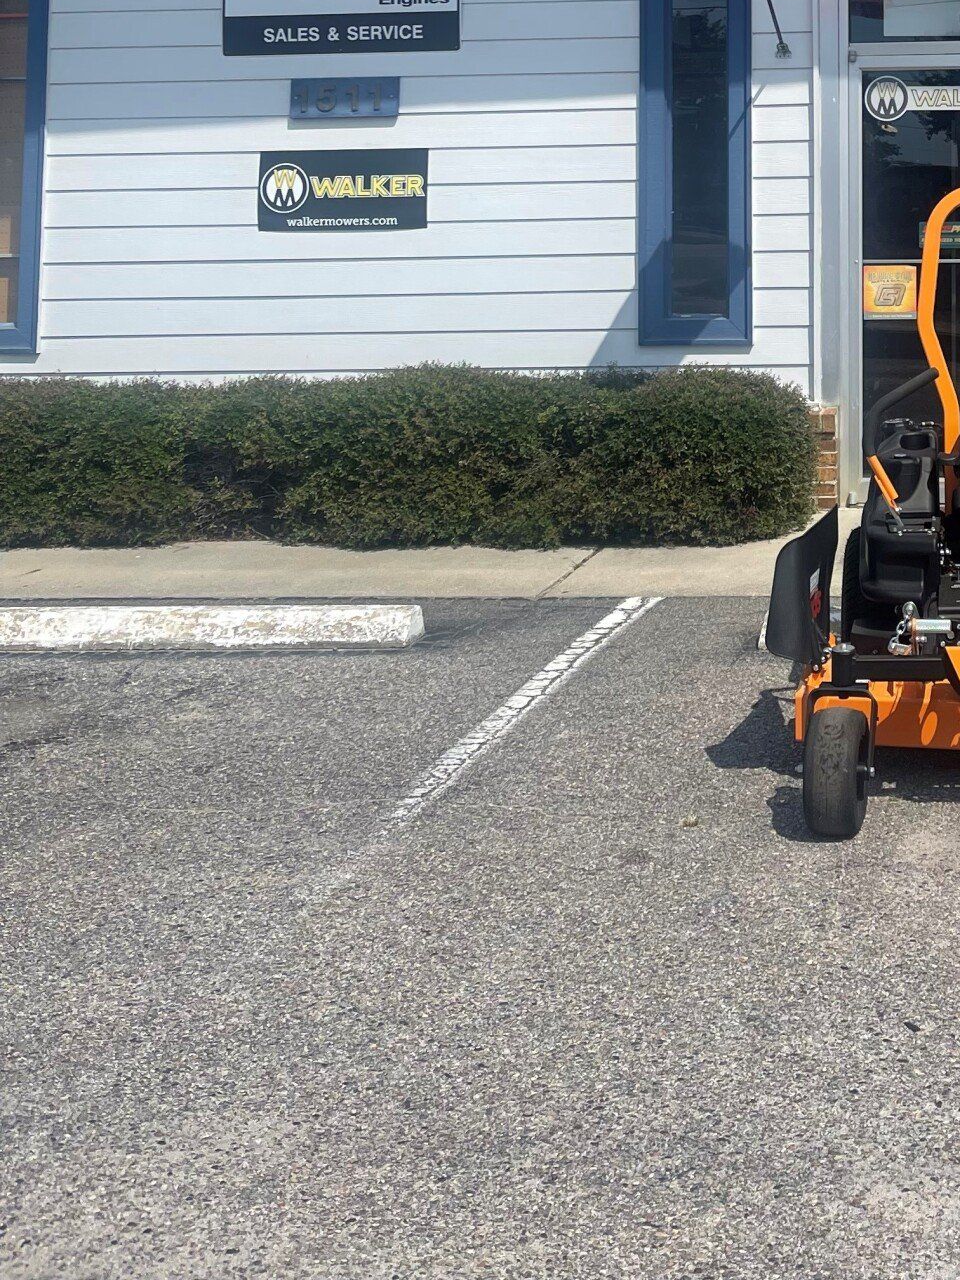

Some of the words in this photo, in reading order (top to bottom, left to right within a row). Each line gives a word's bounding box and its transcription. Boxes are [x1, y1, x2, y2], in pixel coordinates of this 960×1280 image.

[263, 27, 320, 43] SALES
[327, 27, 340, 41] &
[347, 24, 424, 41] SERVICE
[300, 82, 382, 113] 1511
[310, 174, 426, 198] WALKER
[286, 216, 398, 228] walkermowers.com
